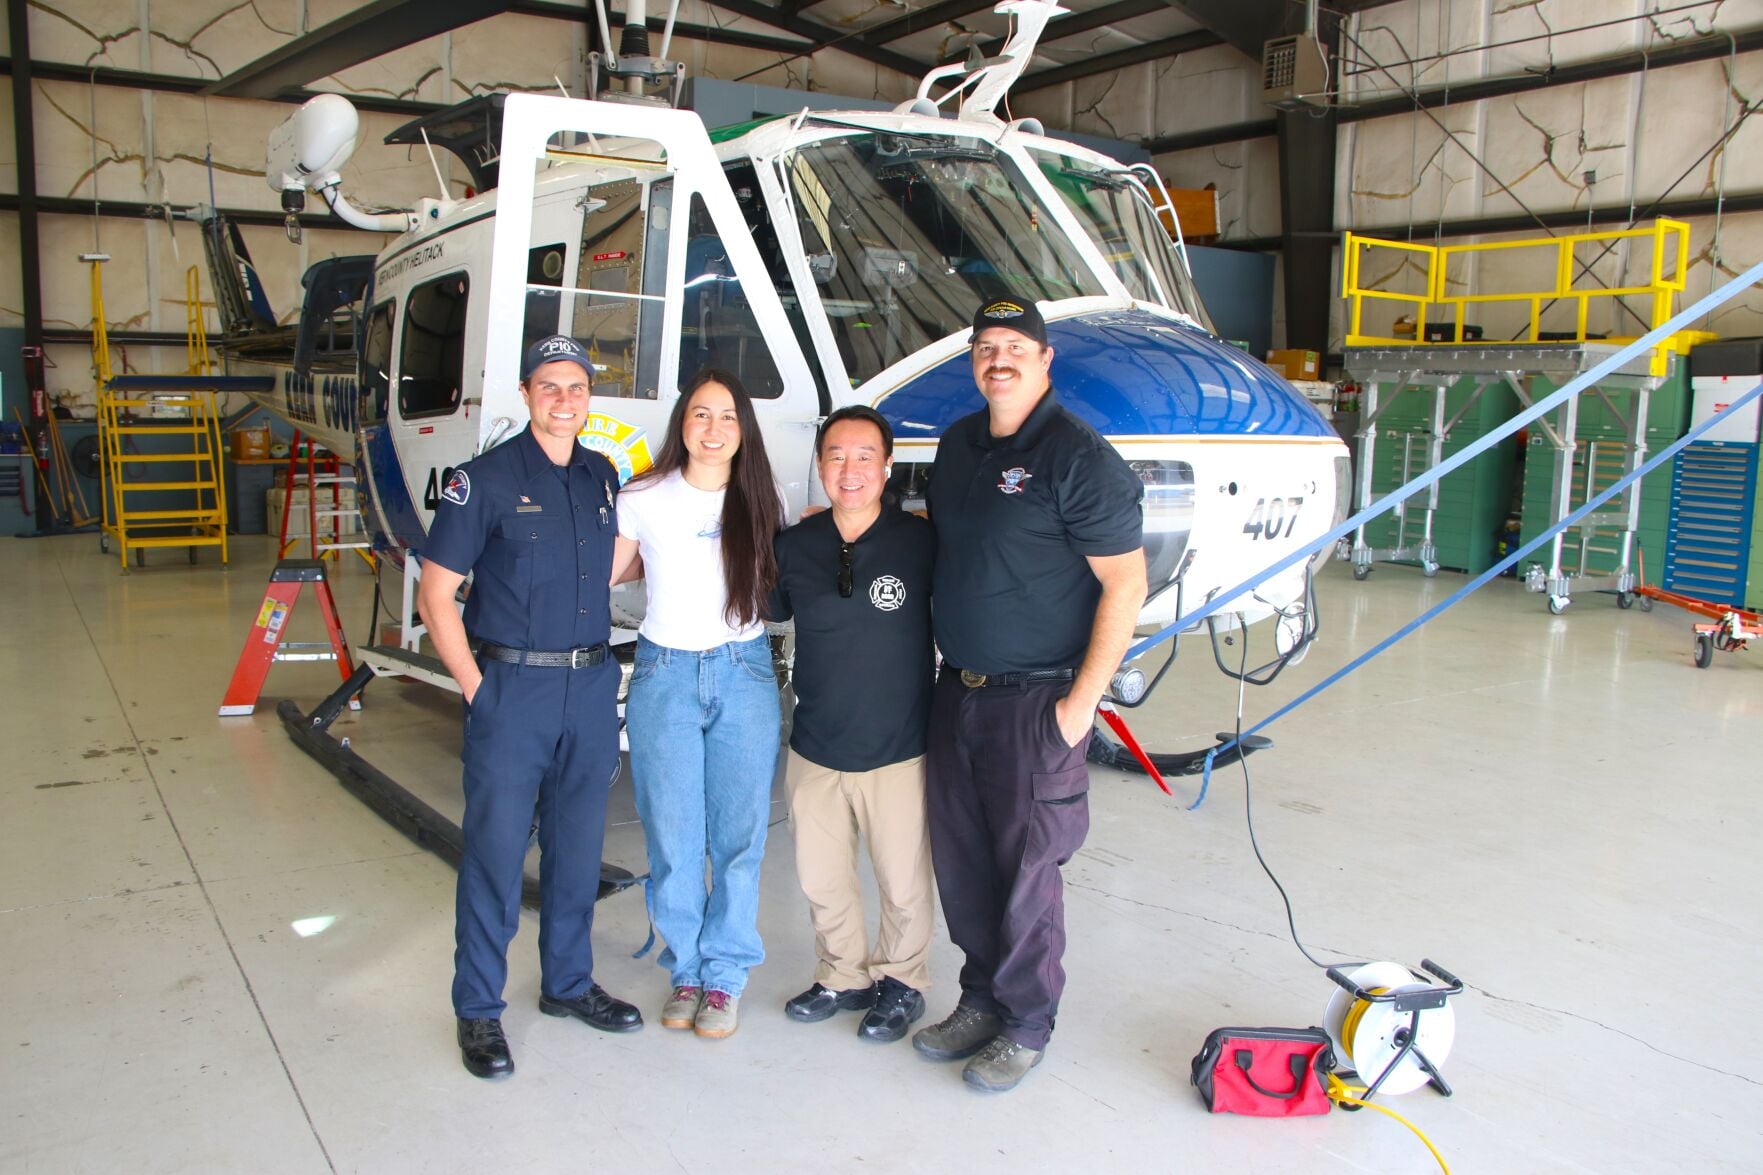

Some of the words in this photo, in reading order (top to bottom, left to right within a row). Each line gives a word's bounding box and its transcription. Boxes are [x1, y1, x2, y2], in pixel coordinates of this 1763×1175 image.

[410, 241, 445, 269] HELITACK
[549, 342, 572, 351] PIO
[584, 417, 617, 436] IRE
[1242, 497, 1303, 541] 407
